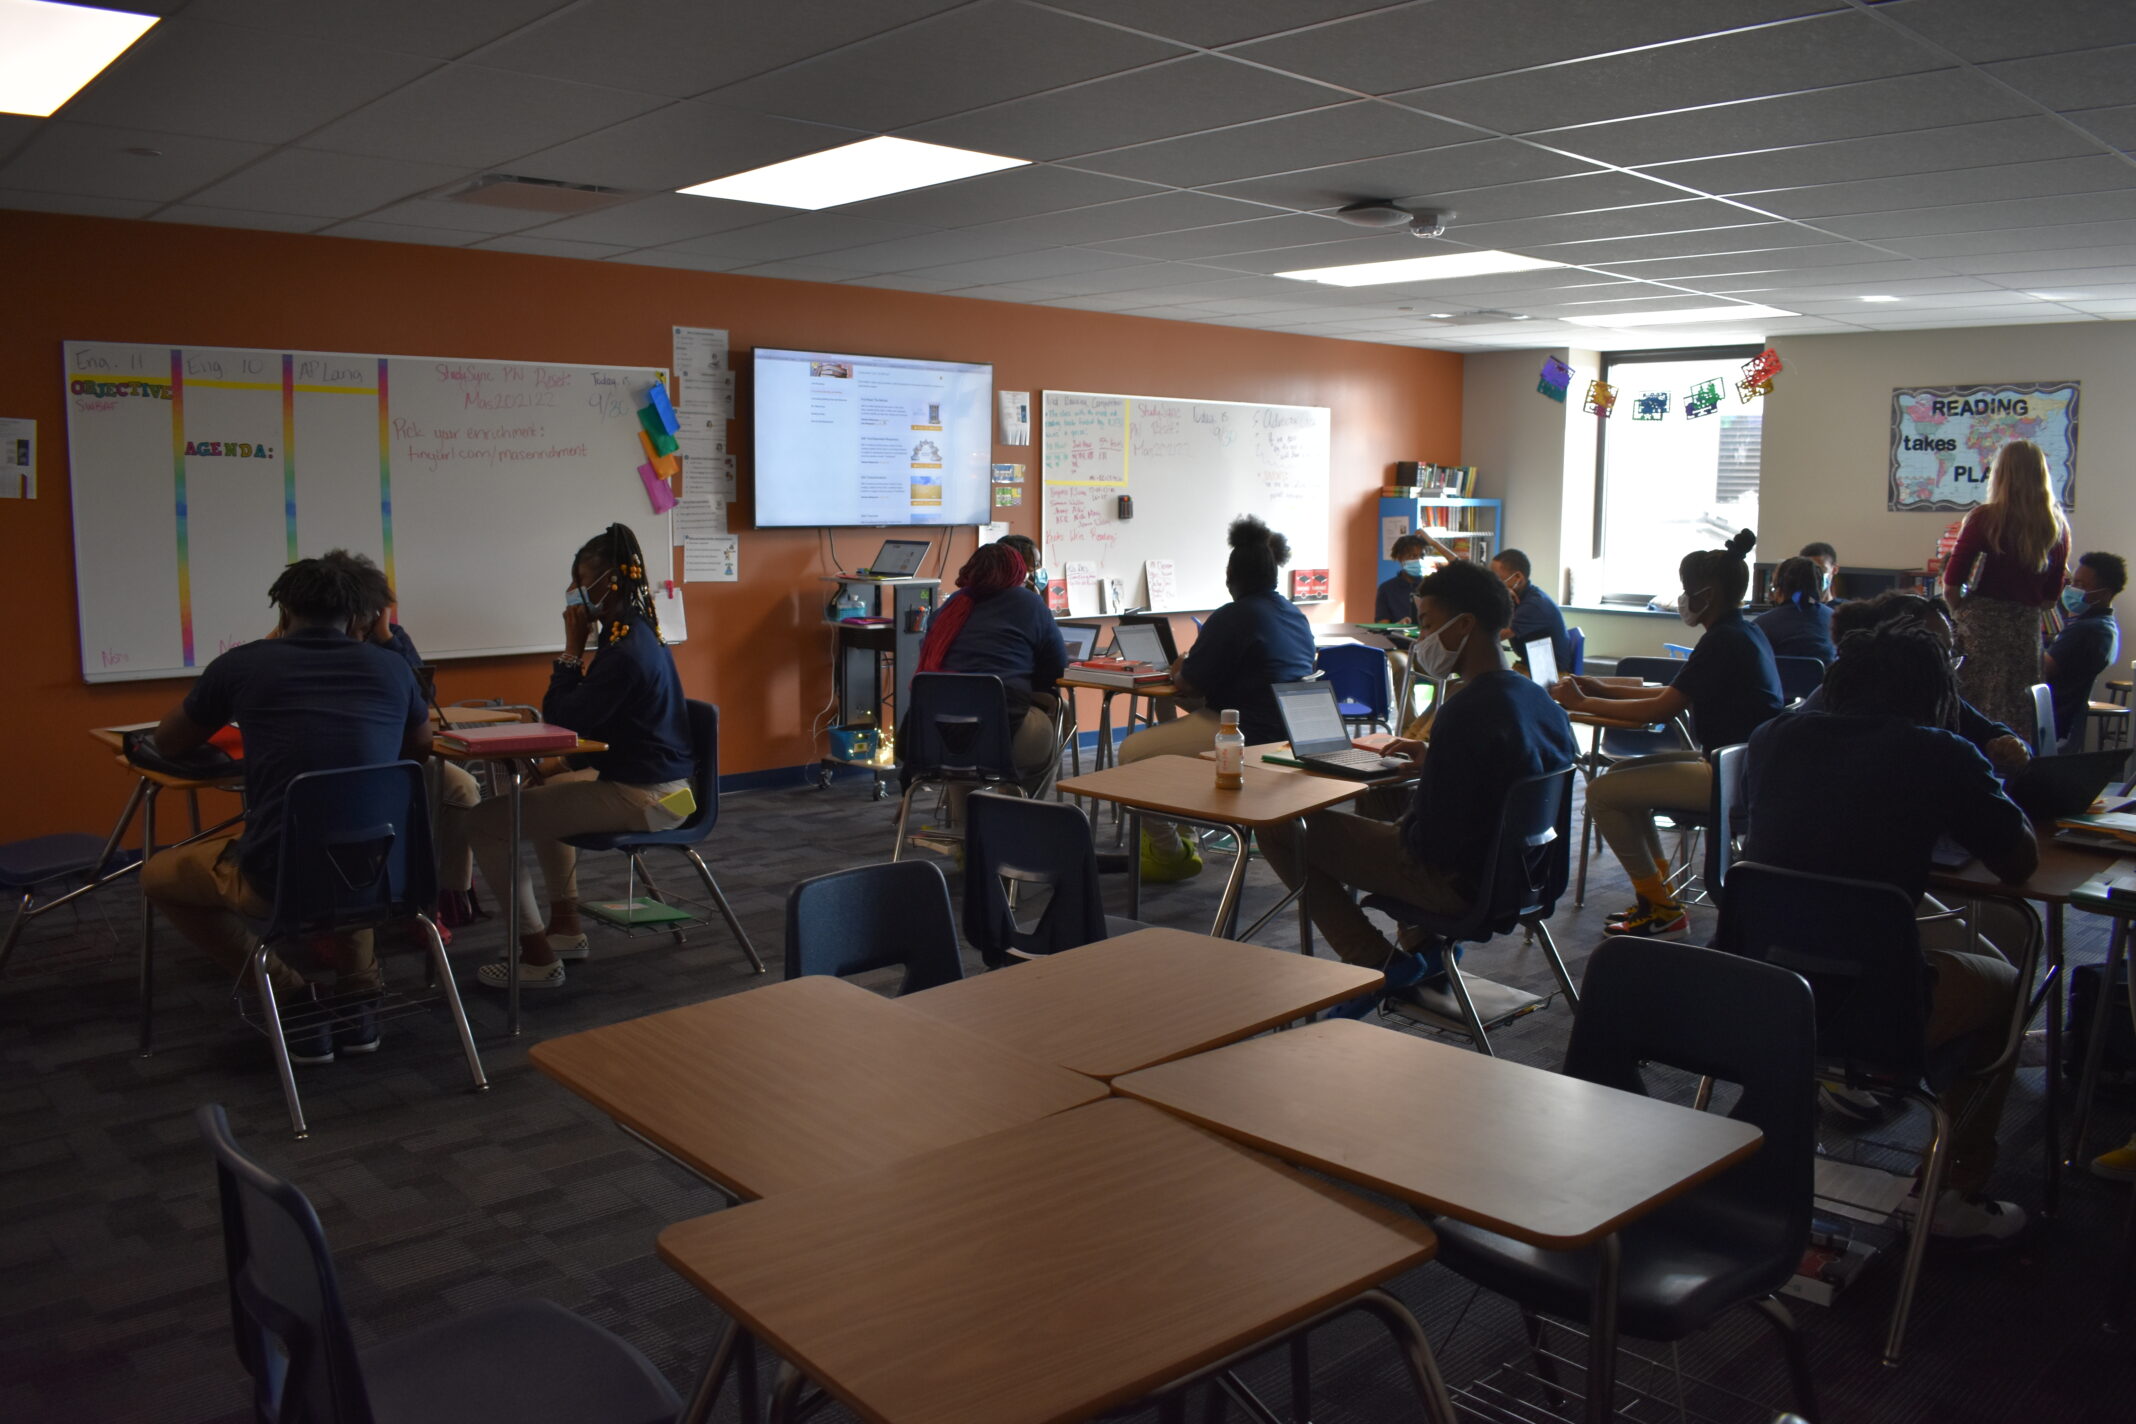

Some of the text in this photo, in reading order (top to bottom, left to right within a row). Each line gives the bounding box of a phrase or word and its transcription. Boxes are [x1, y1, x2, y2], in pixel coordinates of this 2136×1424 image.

[71, 380, 173, 400] OBJECTIVE
[1932, 399, 2028, 417] READING
[184, 441, 274, 459] AGENDA:
[1903, 435, 1957, 452] takes
[1953, 466, 1992, 483] PLA
